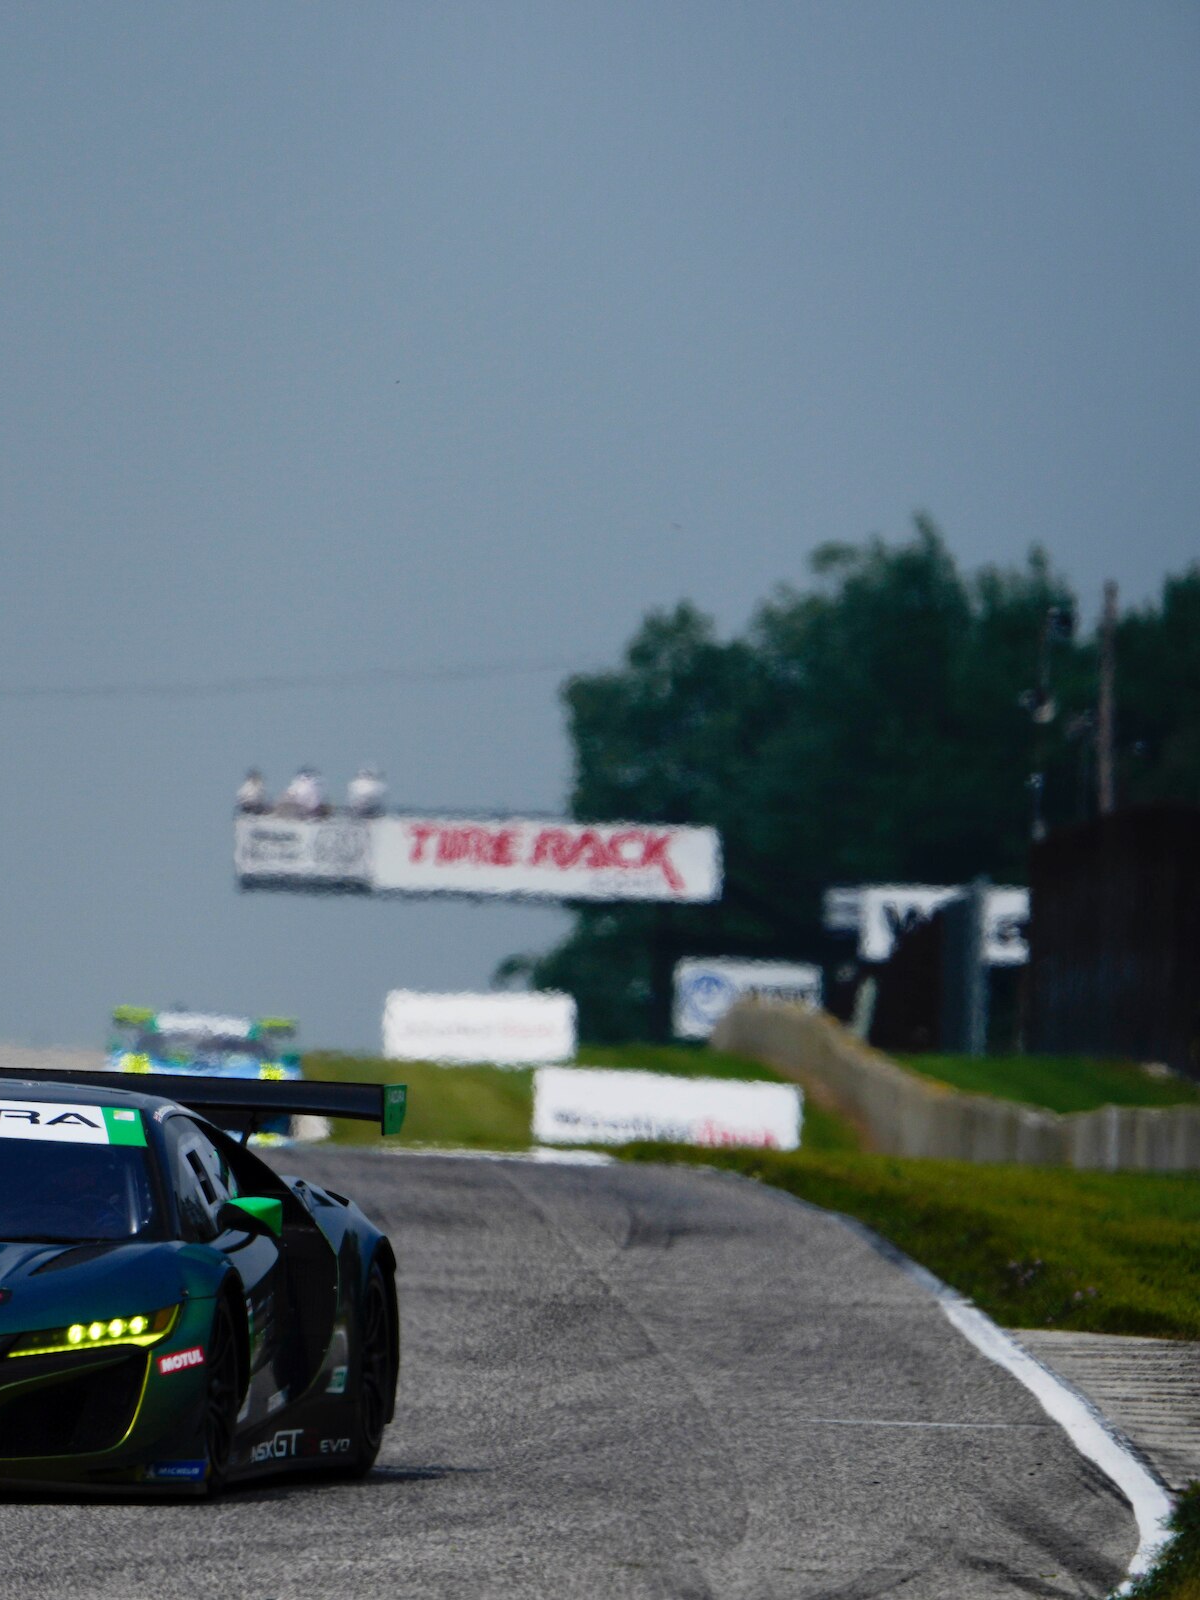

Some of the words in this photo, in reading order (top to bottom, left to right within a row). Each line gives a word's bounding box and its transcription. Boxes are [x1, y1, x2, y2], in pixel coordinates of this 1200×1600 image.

[409, 823, 516, 866] TIRE
[530, 826, 686, 892] RACK
[161, 1349, 204, 1374] MOTUL
